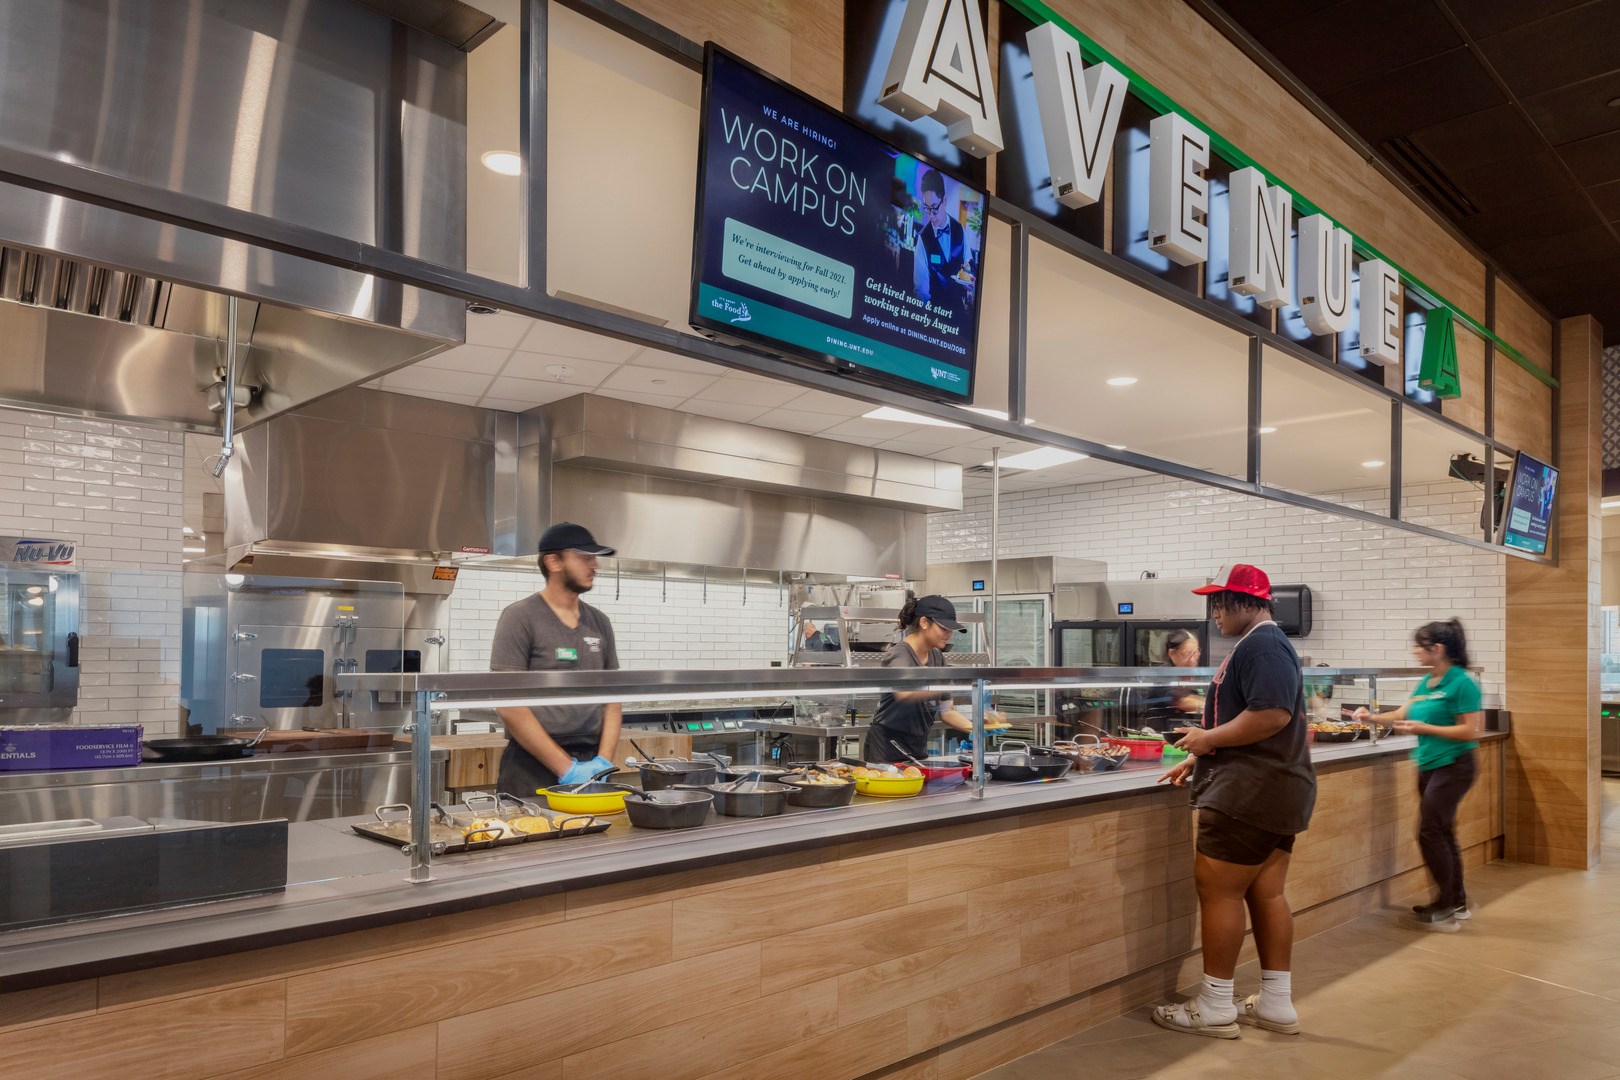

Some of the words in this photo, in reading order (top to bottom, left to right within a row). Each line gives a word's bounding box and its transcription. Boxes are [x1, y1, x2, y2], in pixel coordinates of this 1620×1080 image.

[763, 105, 778, 120] WE
[781, 115, 799, 131] ARE
[802, 126, 837, 150] HIRING!
[721, 108, 819, 185] WORK
[826, 163, 866, 206] ON
[730, 156, 856, 235] CAMPUS
[877, 0, 1400, 366] AVENUE
[1419, 306, 1462, 399] A
[732, 233, 754, 250] We're
[756, 243, 802, 270] interviewing
[801, 261, 814, 271] for
[815, 265, 829, 277] Fall
[829, 271, 846, 285] 2021.
[738, 254, 752, 266] Get
[753, 261, 776, 275] ahead
[778, 268, 787, 281] by
[788, 274, 819, 293] applying
[820, 286, 841, 299] early!
[711, 299, 723, 309] the
[724, 302, 742, 315] Food
[864, 295, 900, 317] working
[900, 305, 910, 318] in
[910, 312, 931, 328] early
[931, 317, 960, 336] August
[865, 277, 881, 292] Get
[882, 283, 906, 301] hired
[906, 295, 924, 308] now
[925, 300, 933, 311] &
[933, 306, 953, 319] start
[826, 336, 874, 356] DINING.UNT.EDU
[862, 314, 880, 326] Apply
[881, 319, 899, 332] online
[900, 326, 907, 334] at
[907, 329, 966, 355] DINING.UNT.EDU/JOBS
[0, 751, 36, 760] ENTIALS
